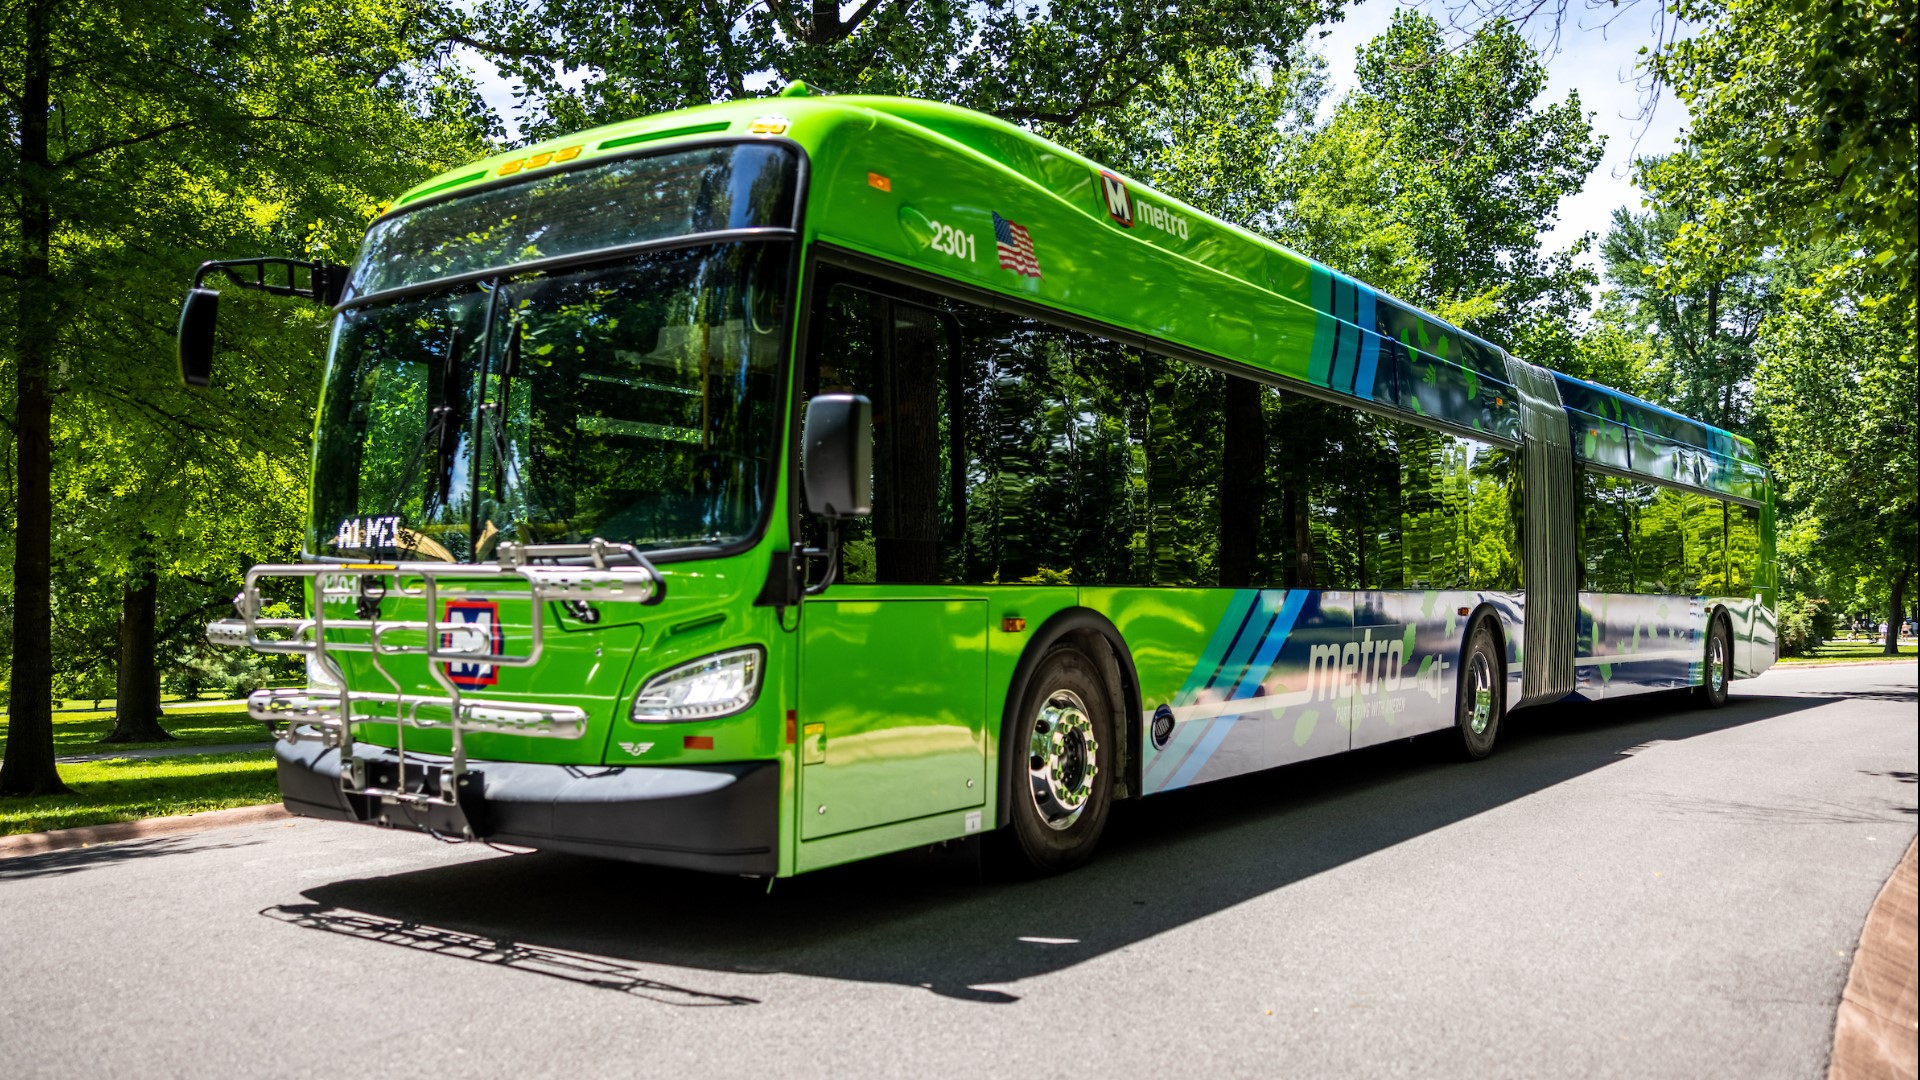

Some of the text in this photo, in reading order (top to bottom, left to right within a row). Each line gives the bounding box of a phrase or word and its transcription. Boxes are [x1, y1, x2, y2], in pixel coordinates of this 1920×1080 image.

[1104, 174, 1189, 240] M metro
[931, 221, 976, 262] 2301
[450, 611, 492, 673] M
[1308, 628, 1404, 704] metro
